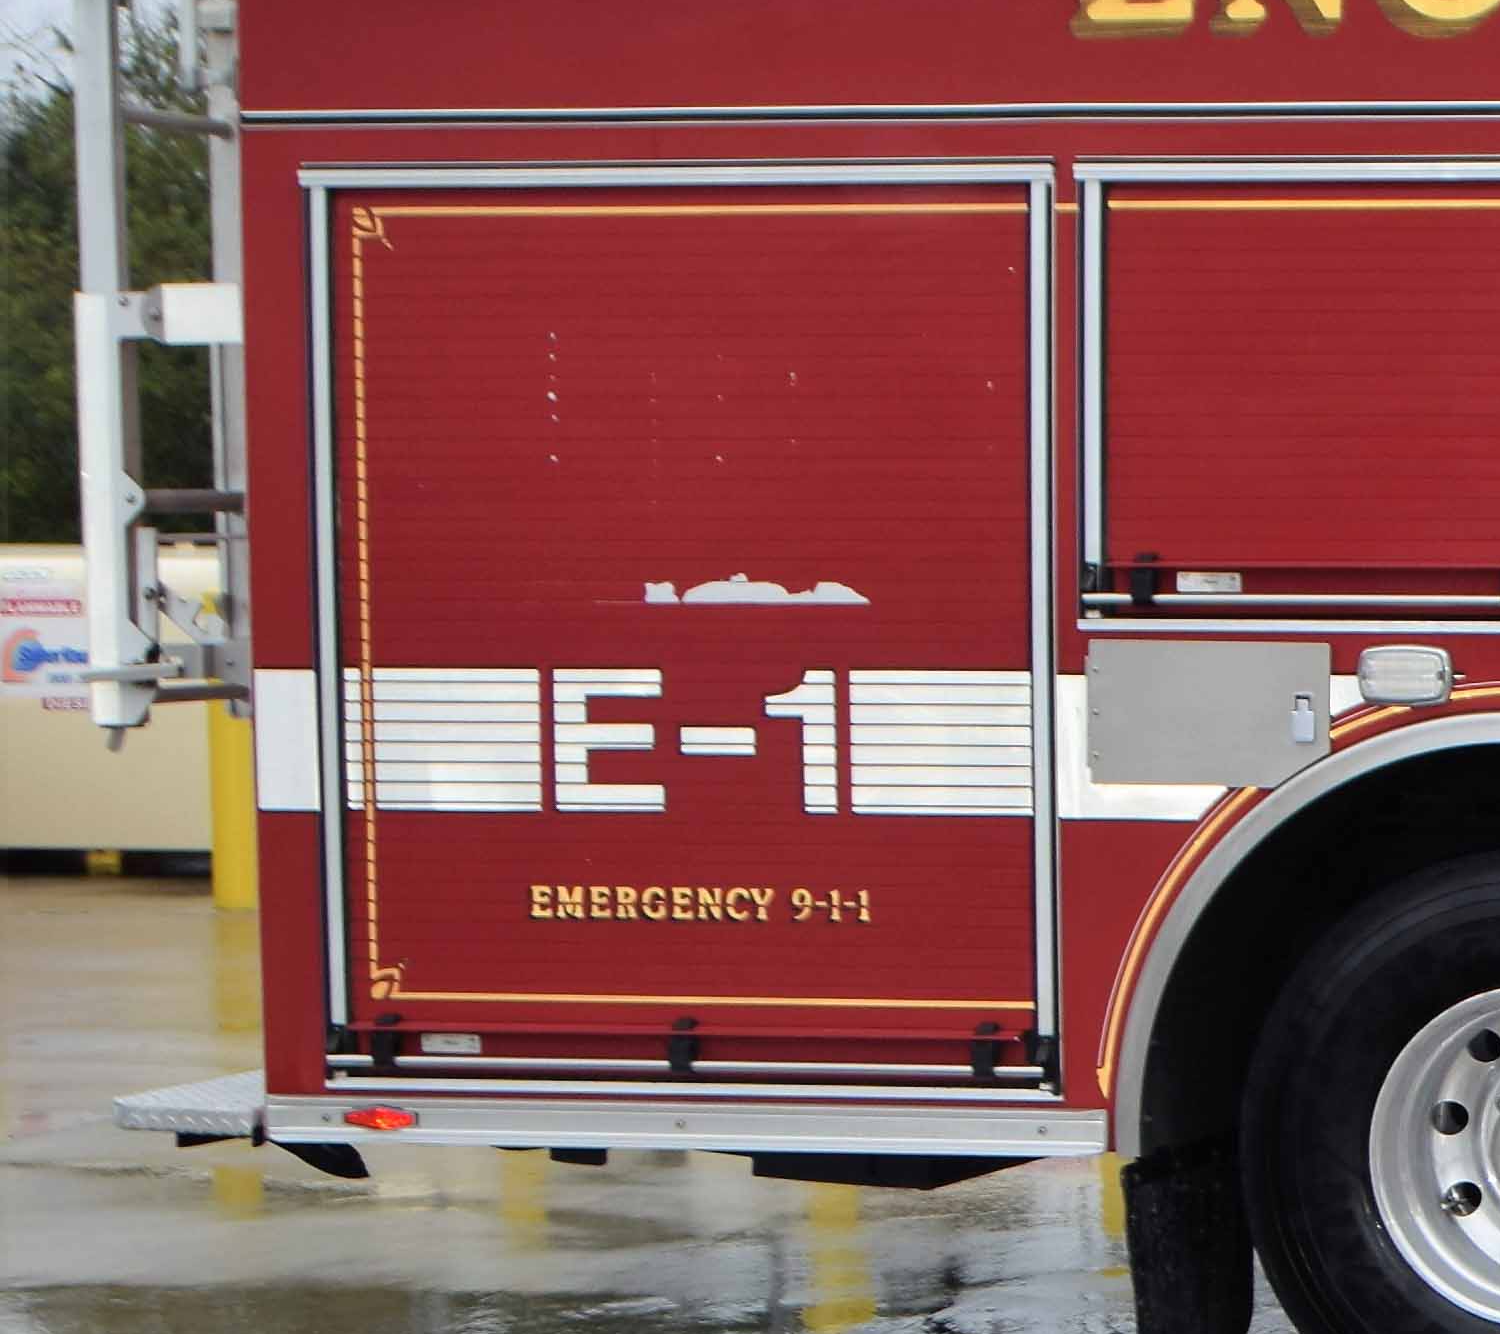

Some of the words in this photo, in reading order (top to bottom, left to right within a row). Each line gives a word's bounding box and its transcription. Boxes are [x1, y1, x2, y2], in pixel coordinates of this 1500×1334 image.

[552, 668, 838, 814] E-1
[529, 884, 775, 922] EMERGENCY
[790, 888, 871, 923] 9-1-1
